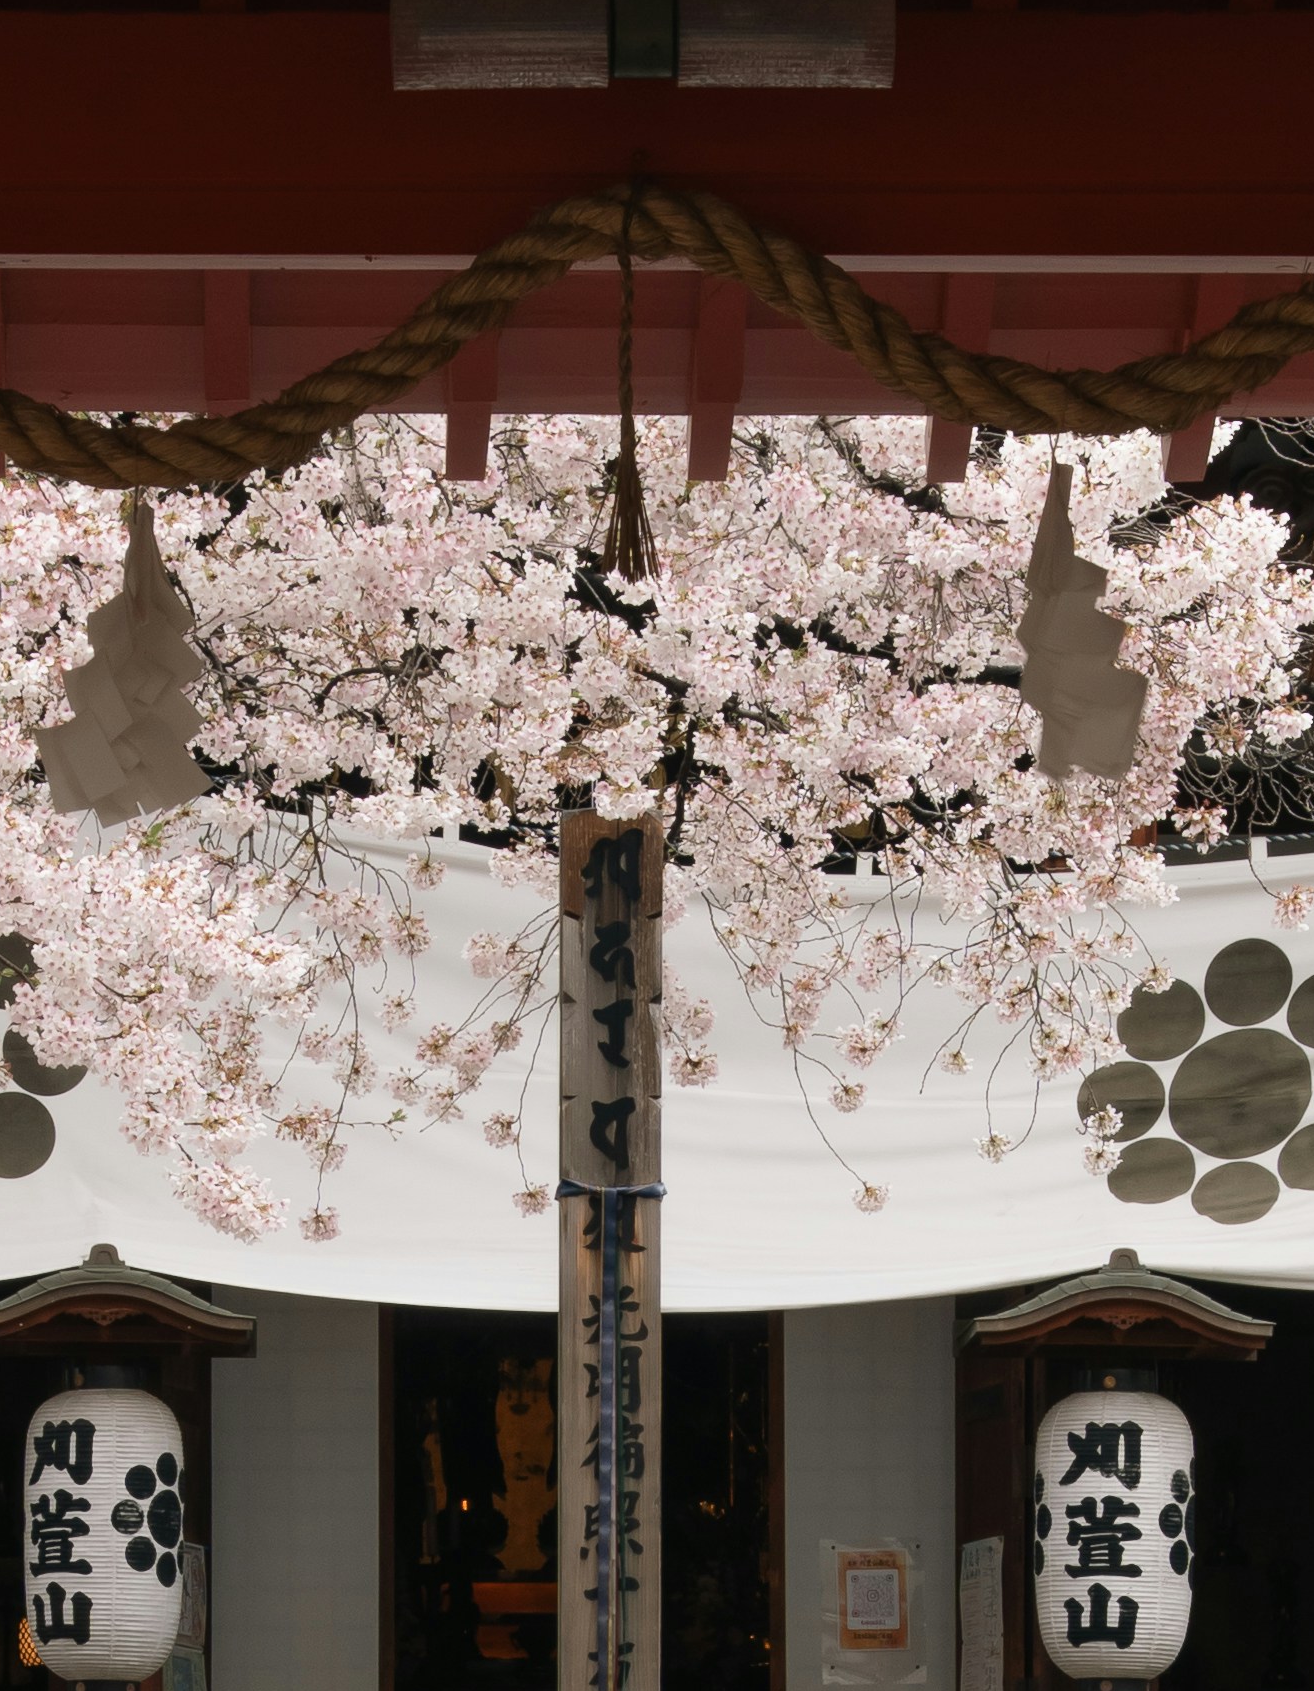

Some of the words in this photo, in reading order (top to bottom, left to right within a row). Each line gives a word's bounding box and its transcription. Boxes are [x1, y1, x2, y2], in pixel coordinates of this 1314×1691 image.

[29, 1418, 96, 1646] 刈萱山
[1059, 1420, 1144, 1649] 刈萱山
